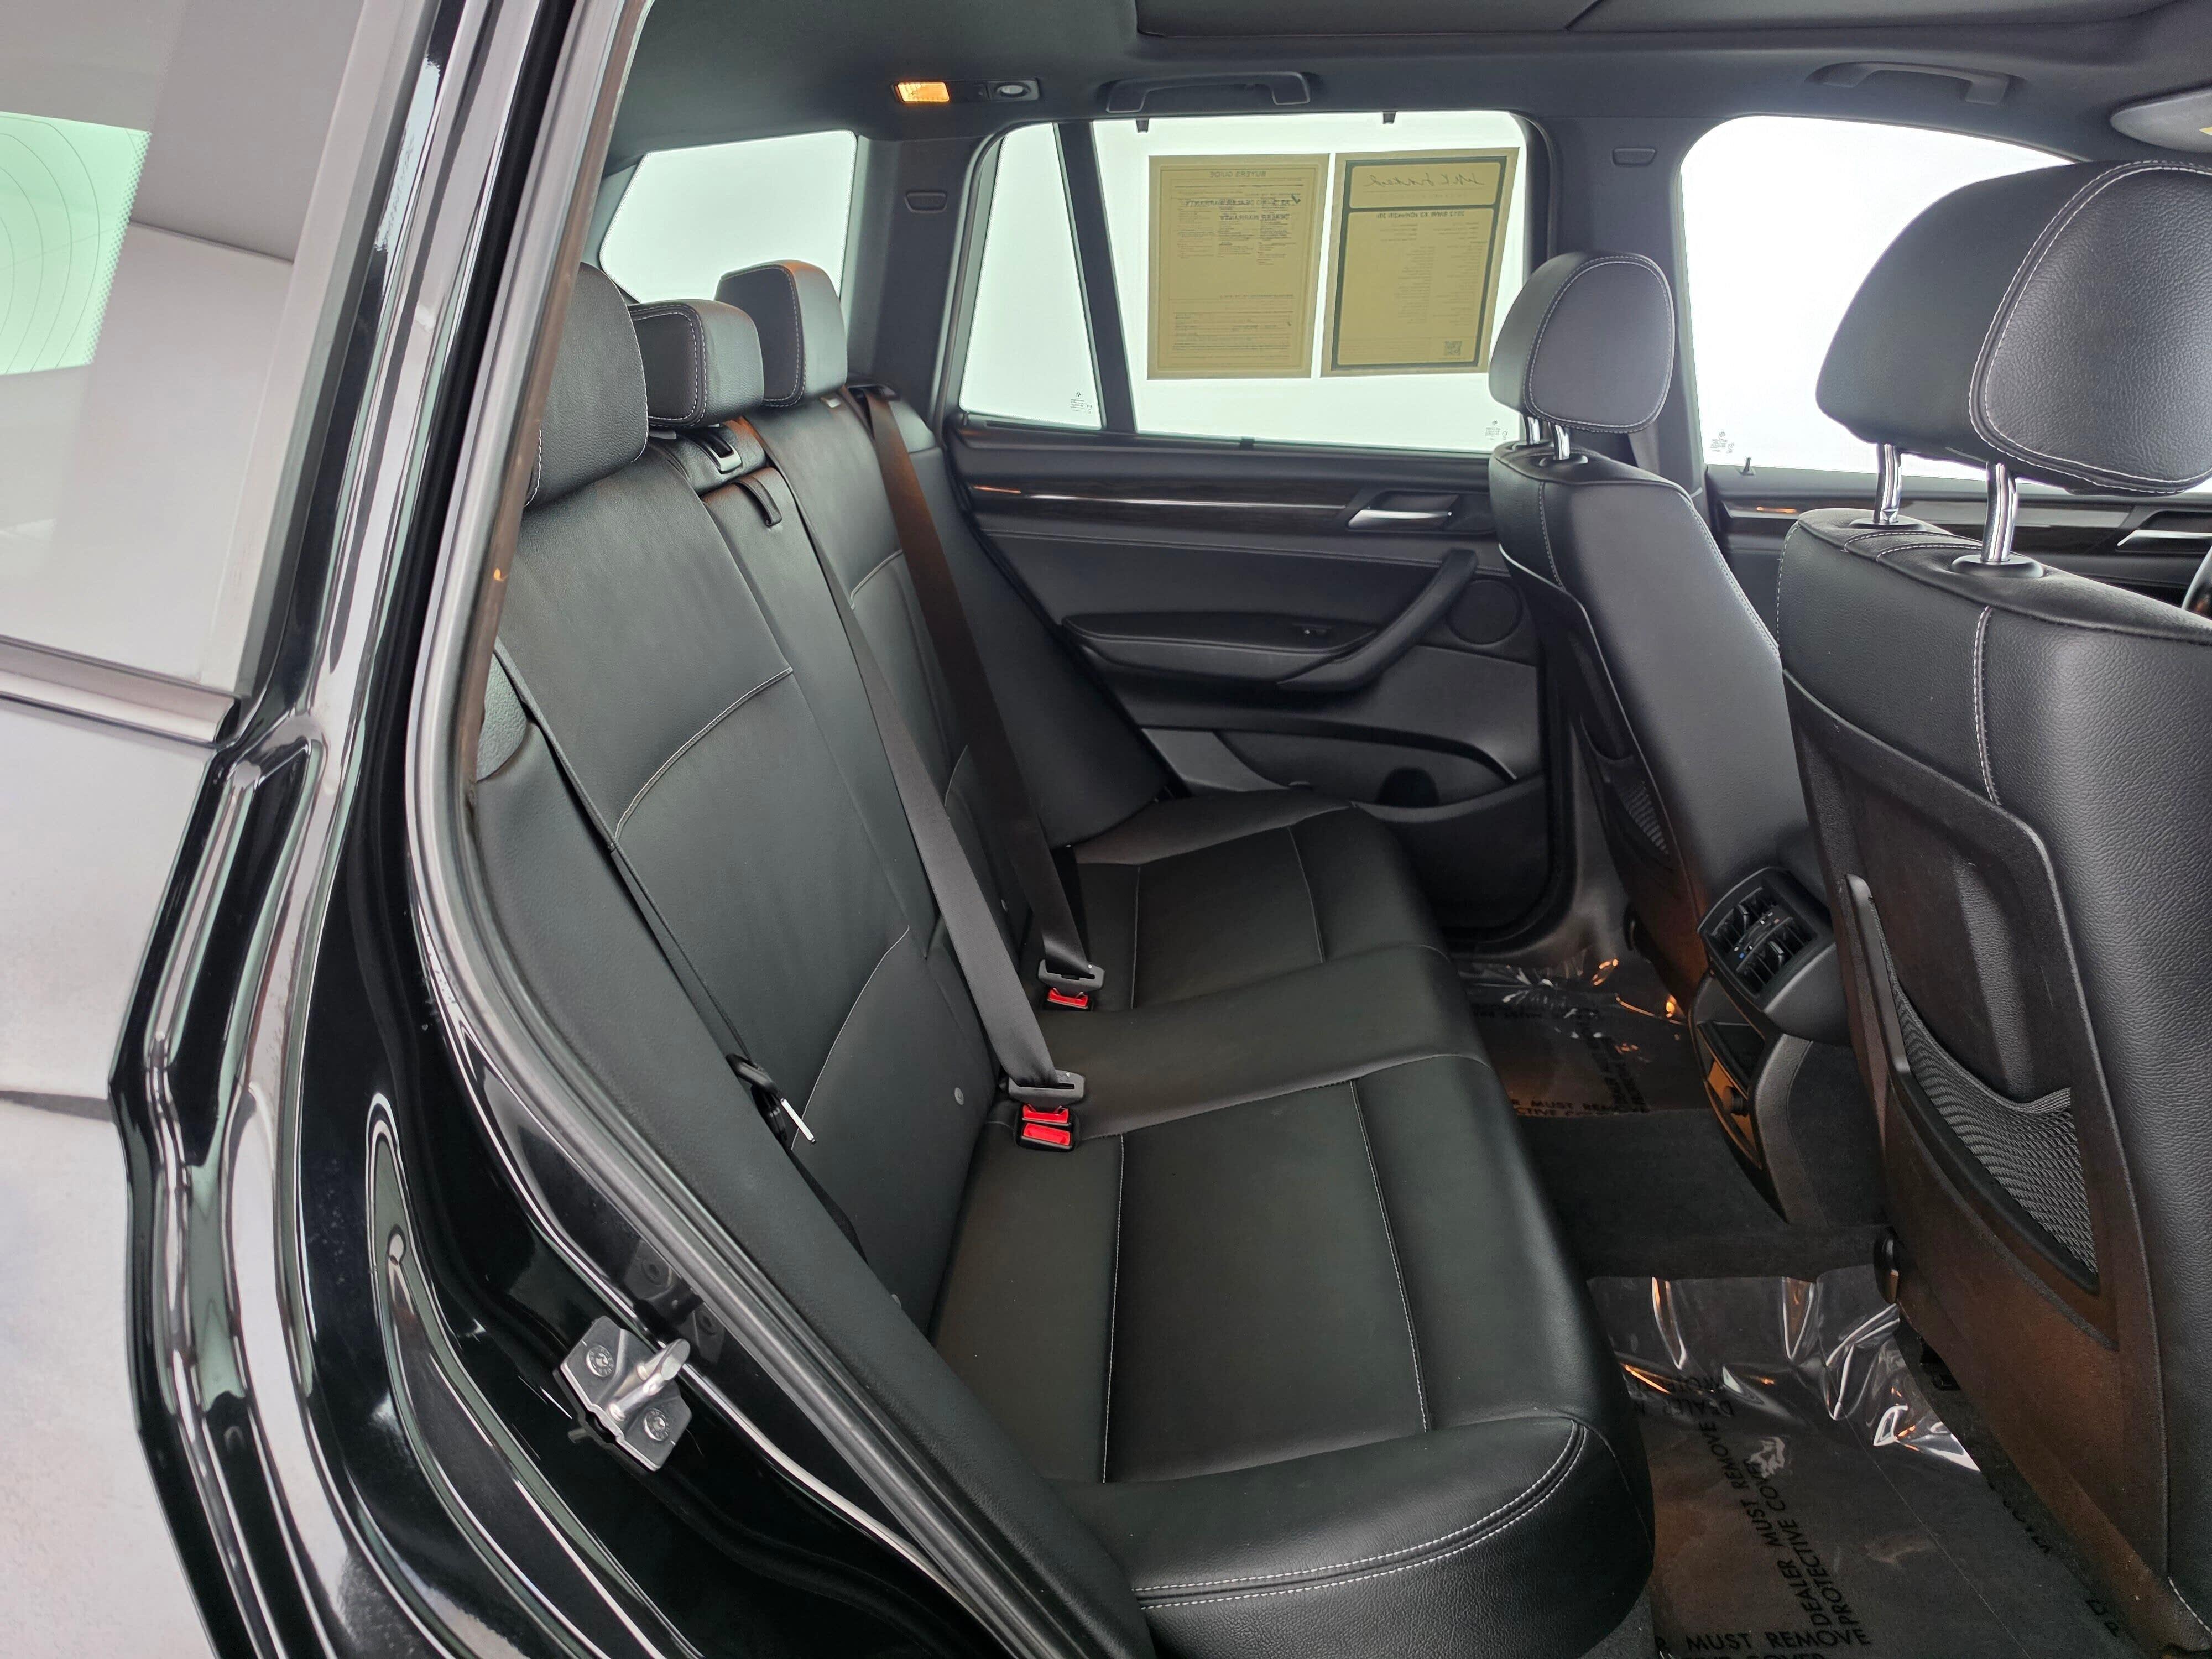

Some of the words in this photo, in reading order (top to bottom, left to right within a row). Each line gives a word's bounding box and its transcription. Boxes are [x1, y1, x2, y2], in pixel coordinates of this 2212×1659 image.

[1698, 1420, 1750, 1490] REMOVE
[1740, 1499, 1785, 1548] MUST
[1776, 1559, 1832, 1626] DEALER
[1777, 1518, 1859, 1625] PROTECTIVE
[1685, 1631, 1754, 1652] MUST
[1764, 1627, 1872, 1650] REMOVE
